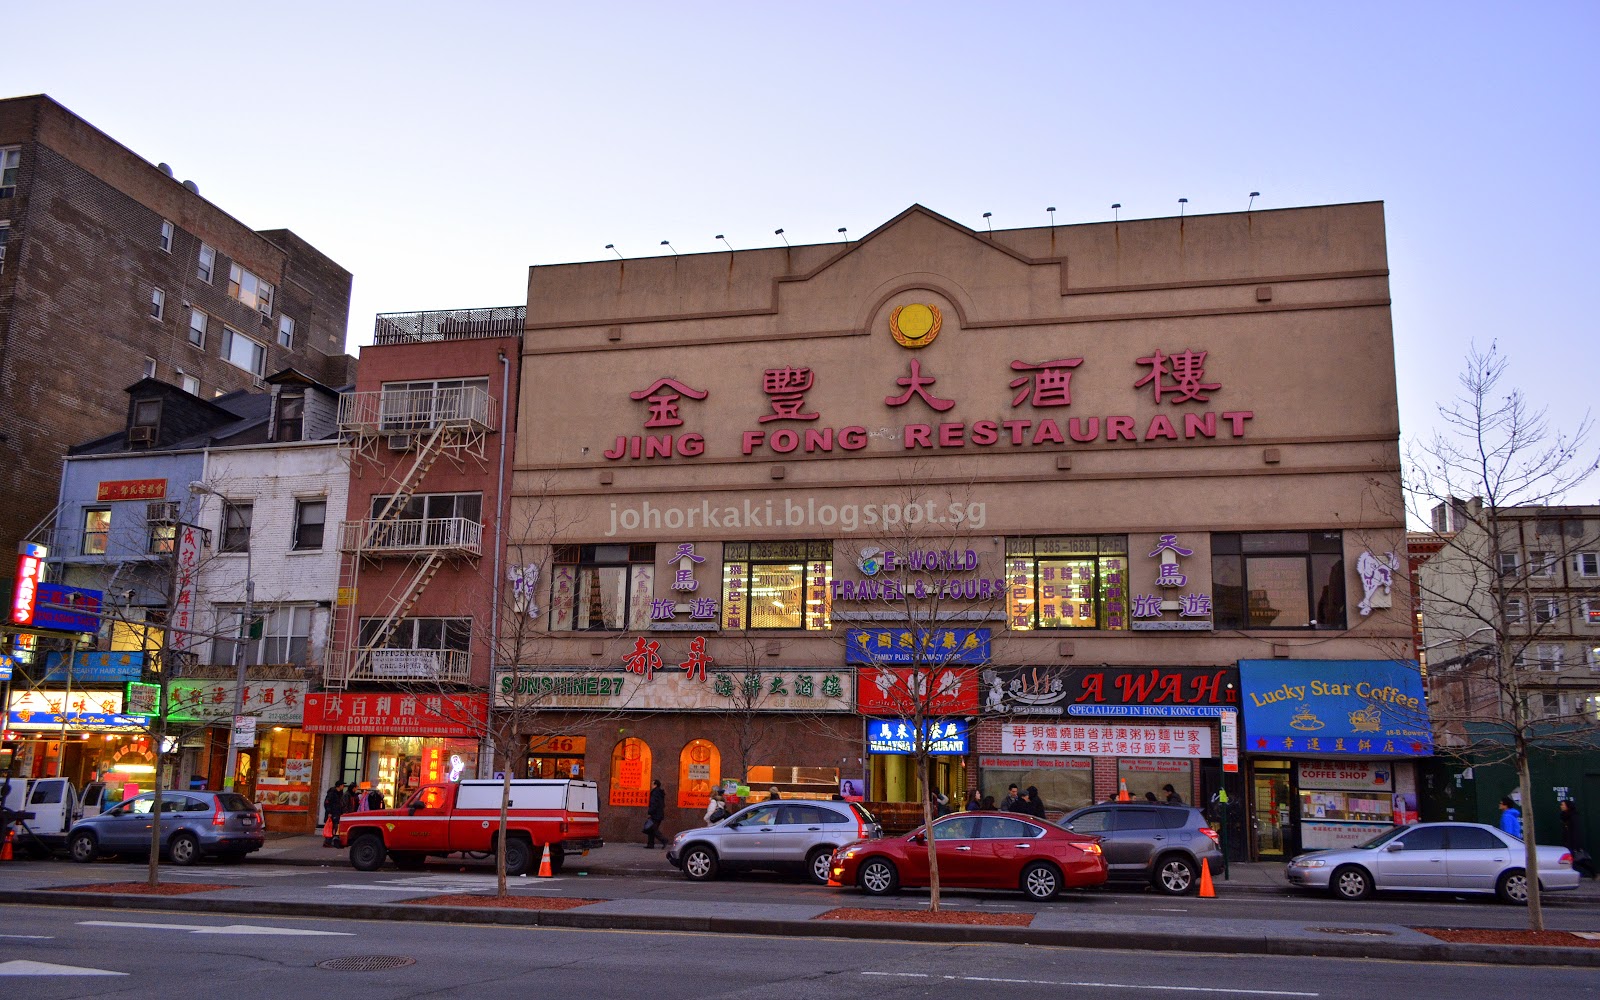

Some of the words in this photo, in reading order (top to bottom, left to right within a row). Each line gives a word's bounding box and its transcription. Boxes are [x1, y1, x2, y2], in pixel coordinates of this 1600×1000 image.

[630, 348, 1222, 427] 金豐大酒樓
[605, 433, 705, 459] JING
[742, 426, 867, 454] FONG
[904, 411, 1253, 445] RESTAURANT
[1043, 540, 1091, 553] 385-1688
[668, 543, 705, 590] 天馬
[884, 550, 978, 571] E-WORLD
[1148, 534, 1193, 586] 天馬
[830, 580, 905, 600] TRAVEL
[914, 579, 928, 600] &
[936, 579, 1005, 600] TOURS
[650, 598, 716, 619] 旅遊
[1132, 593, 1211, 617] 旅遊
[1075, 674, 1107, 703] A
[1114, 669, 1226, 703] WAH
[1250, 683, 1306, 708] Lucky
[1310, 680, 1351, 697] Star
[1356, 682, 1419, 709] Coffee
[348, 716, 387, 725] BOWERY
[393, 717, 419, 725] MALL
[1071, 704, 1127, 716] SPECIALIZED
[1129, 706, 1140, 715] IN
[1142, 706, 1168, 716] HONG
[1170, 706, 1197, 716] KONG
[547, 739, 573, 752] 46
[912, 740, 964, 752] RAURANT
[1281, 736, 1396, 753] 幸運星餅店
[1302, 771, 1337, 779] COFFEE
[1340, 771, 1367, 780] SHOP
